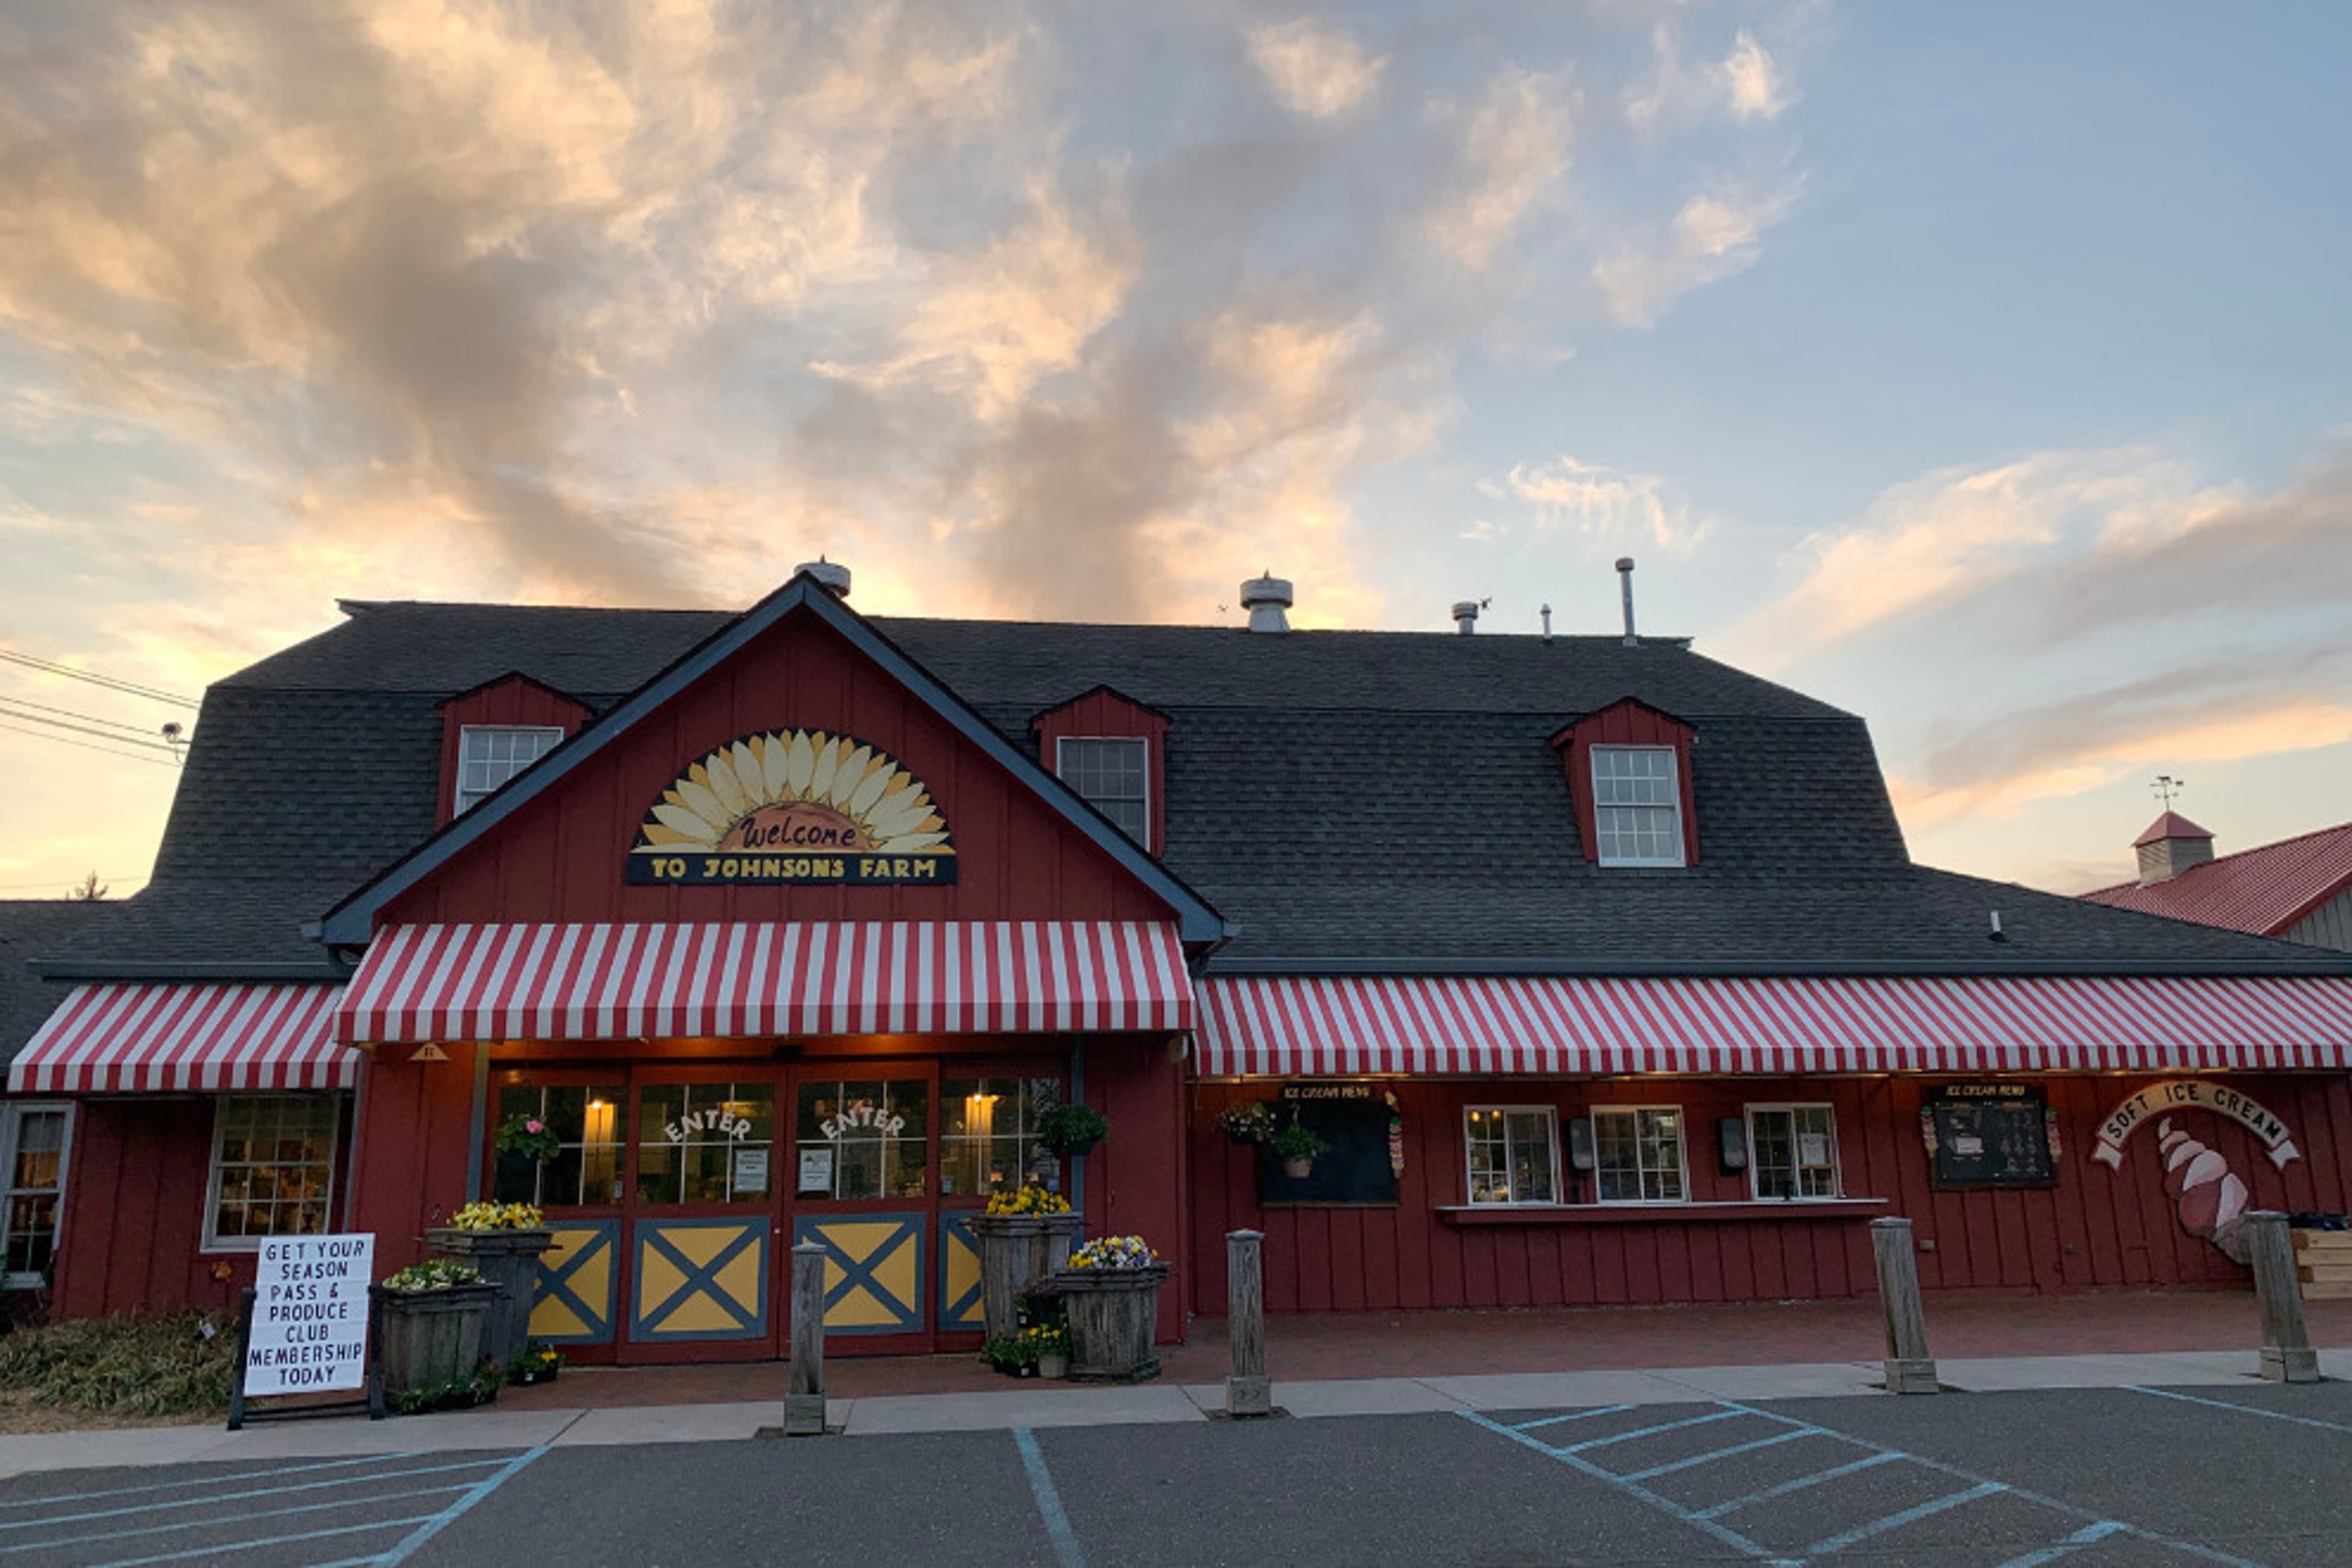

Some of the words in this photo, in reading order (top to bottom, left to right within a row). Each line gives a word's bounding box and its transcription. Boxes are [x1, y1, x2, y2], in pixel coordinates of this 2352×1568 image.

[741, 816, 856, 849] Welcome
[652, 858, 687, 878] TO
[859, 859, 937, 878] FARM
[2107, 1095, 2149, 1138] SOFT
[2165, 1083, 2200, 1102] ICE
[2214, 1089, 2282, 1140] CREAM
[664, 1109, 751, 1143] ENTER
[820, 1107, 905, 1140] ENTER
[266, 1243, 306, 1261] GET
[317, 1240, 364, 1257] YOUR
[282, 1261, 348, 1280] SEASON
[271, 1285, 317, 1301] PASS
[330, 1283, 339, 1298] &
[270, 1302, 348, 1321] PRODUCE
[285, 1324, 329, 1343] CLUB
[249, 1343, 363, 1366] MEMBERSHIP
[279, 1366, 336, 1385] TODAY
